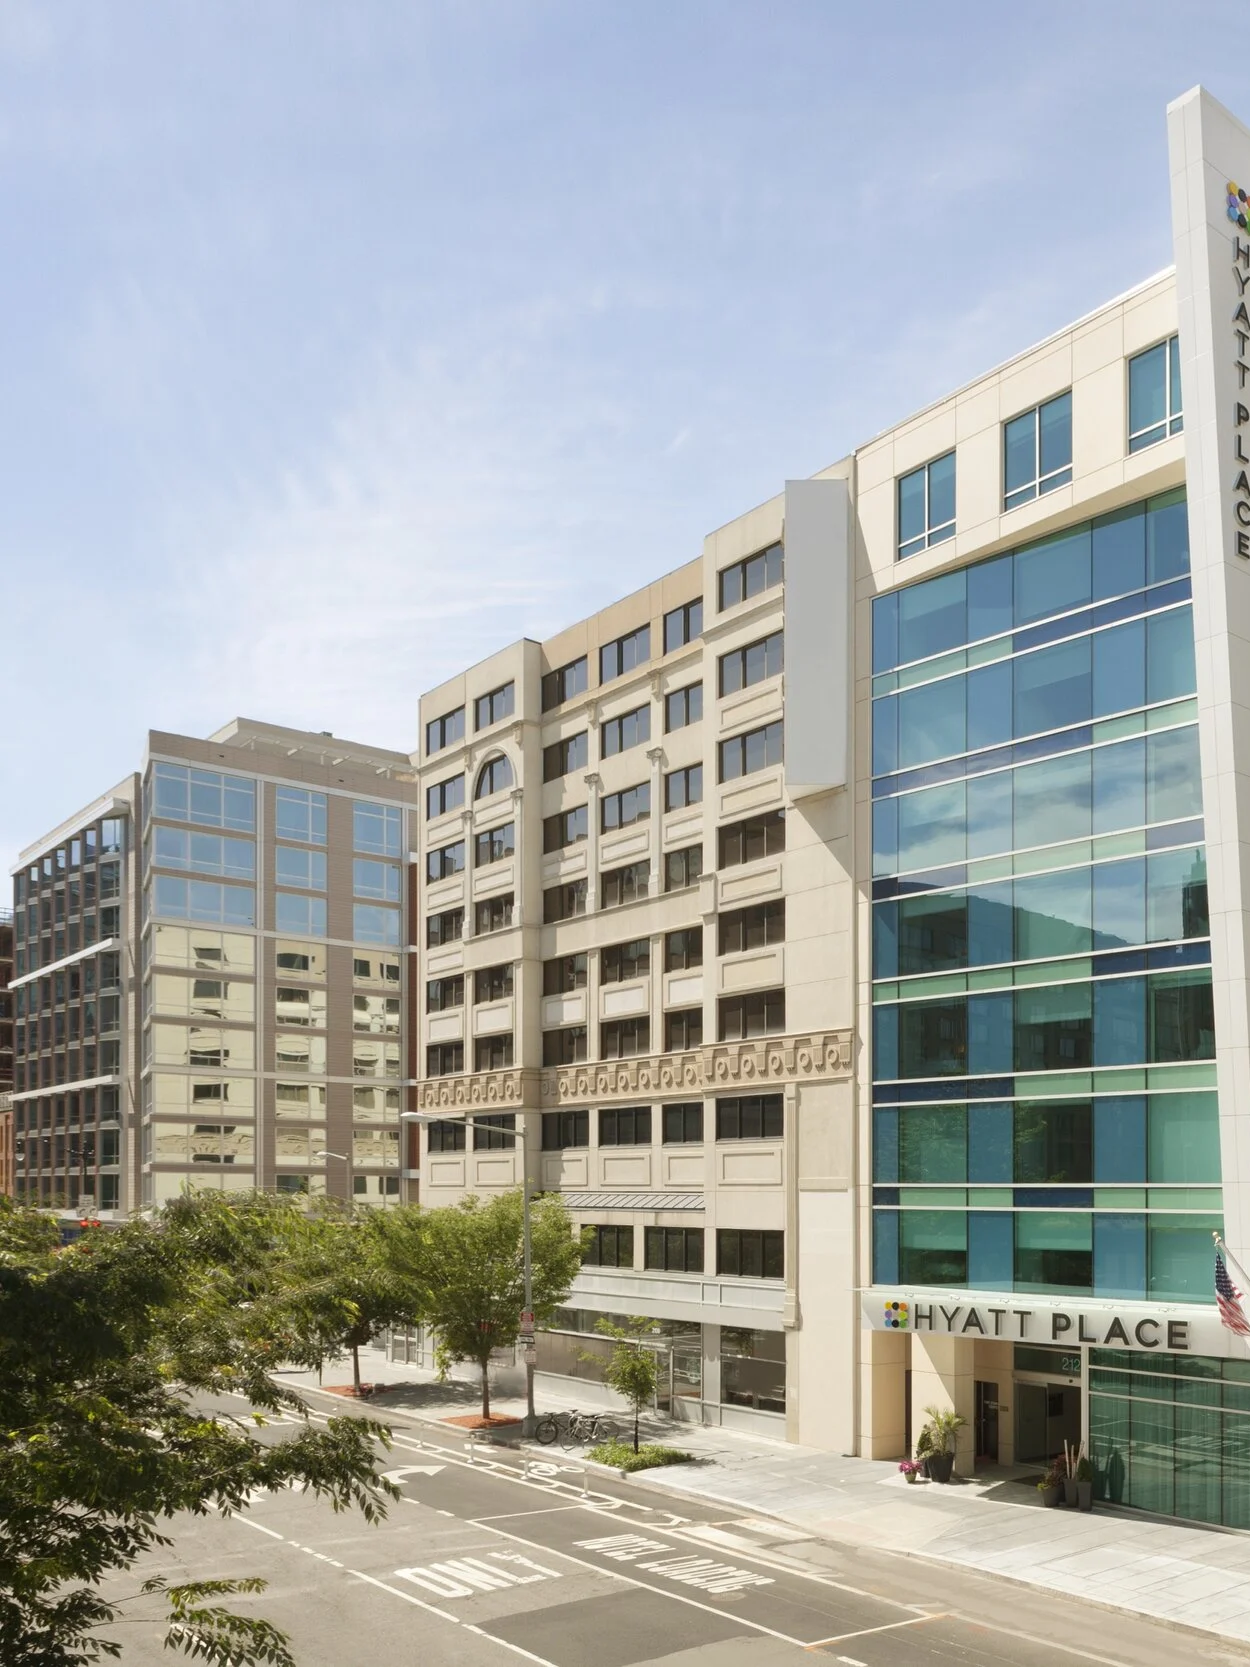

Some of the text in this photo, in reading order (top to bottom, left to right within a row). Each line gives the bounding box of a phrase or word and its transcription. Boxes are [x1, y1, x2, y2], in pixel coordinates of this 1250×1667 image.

[914, 1303, 1190, 1350] HYATT PLACE
[1061, 1357, 1081, 1372] 212
[392, 1549, 564, 1598] ONLY
[571, 1533, 776, 1594] HOTEL LOADING
